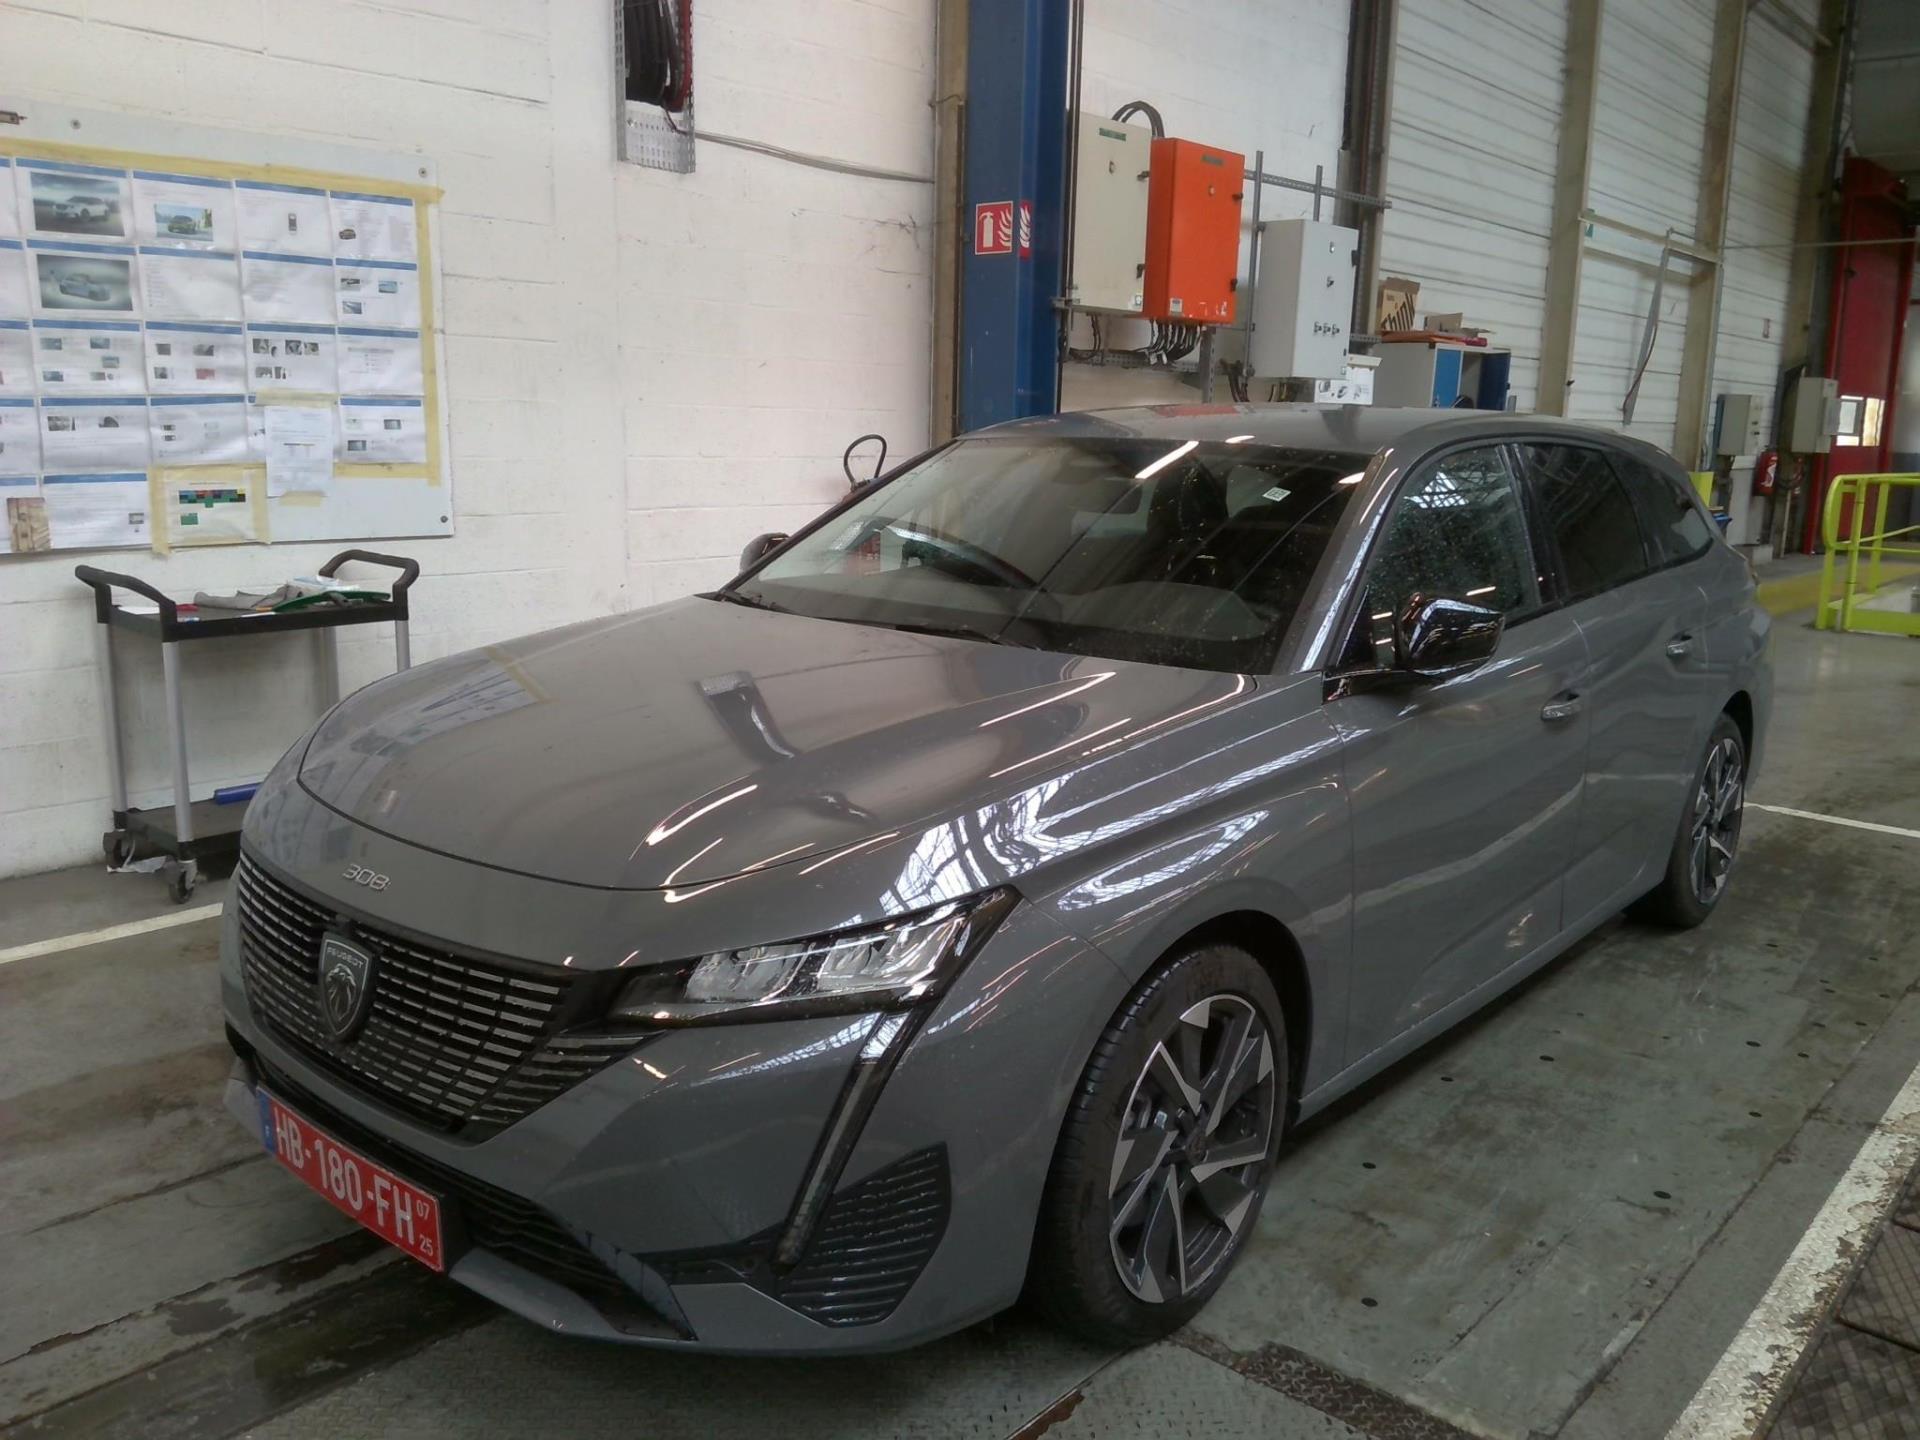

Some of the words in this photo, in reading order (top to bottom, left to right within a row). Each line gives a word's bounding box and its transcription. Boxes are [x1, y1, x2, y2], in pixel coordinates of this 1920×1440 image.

[342, 863, 390, 891] 308
[326, 946, 364, 969] PEUGEOT
[274, 1106, 415, 1246] HB-180-FH
[416, 1199, 431, 1221] 07
[419, 1234, 434, 1257] 25
